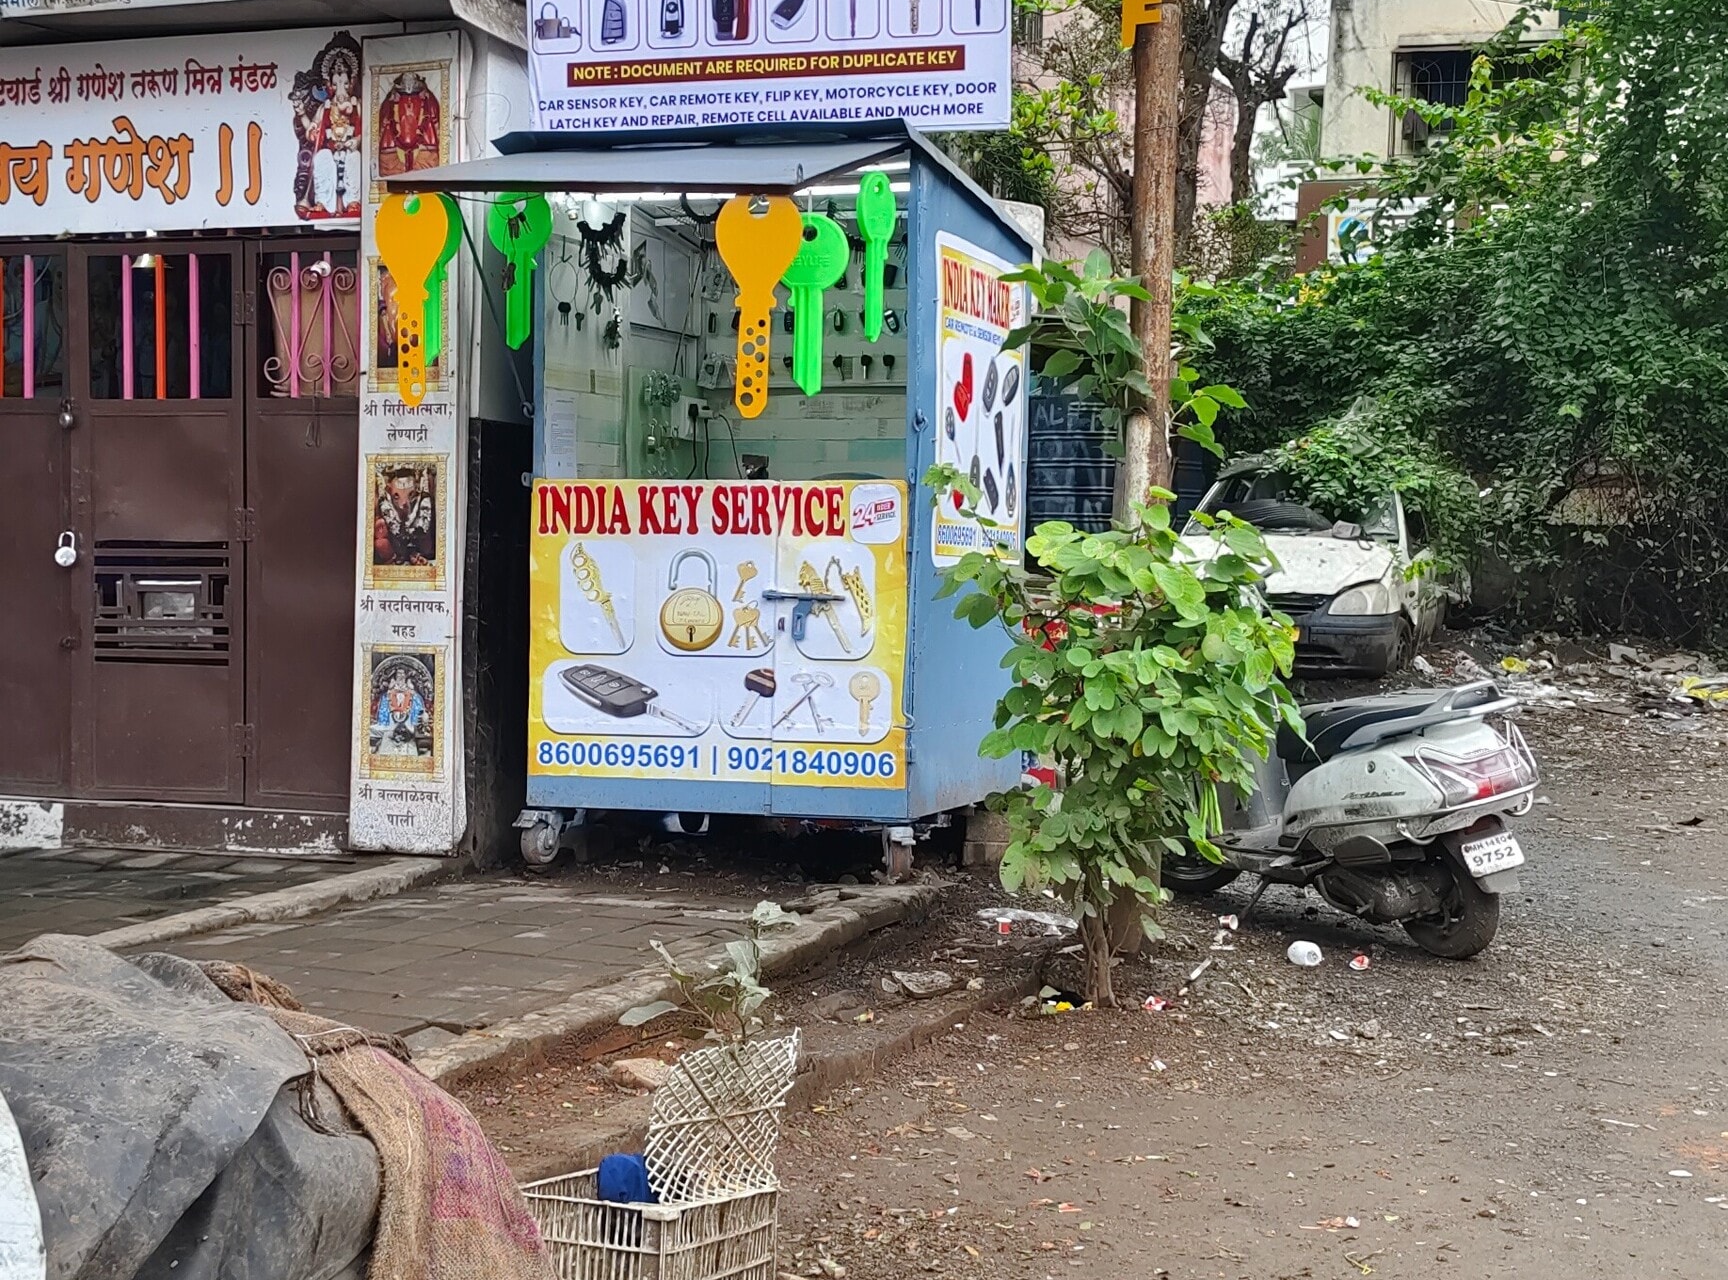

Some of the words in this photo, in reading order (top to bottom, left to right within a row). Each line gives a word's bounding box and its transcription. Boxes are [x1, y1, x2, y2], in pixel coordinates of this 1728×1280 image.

[47, 65, 71, 105] श्री
[76, 62, 126, 102] गणेश
[131, 67, 179, 99] तरूण
[184, 58, 224, 97] मित्र
[228, 53, 279, 94] मंडळ
[573, 66, 611, 81] NOTE
[620, 62, 703, 79] DOCUMENT
[705, 60, 733, 75] ARE
[735, 56, 808, 74] REQUIRED
[810, 55, 840, 70] FOR
[842, 51, 925, 68] DUPLICATE
[928, 50, 958, 65] KEY
[539, 99, 565, 112] CAR
[567, 97, 617, 110] SENSOR
[619, 96, 648, 110] KEY,
[649, 94, 678, 107] CAR
[680, 92, 732, 106] REMOTE
[734, 91, 763, 105] KEY,
[765, 90, 791, 102] FLIP
[794, 88, 824, 103] KEY,
[825, 84, 920, 100] MOTORCYCLE
[923, 83, 953, 98] KEY,
[955, 81, 997, 95] DOOR
[549, 118, 592, 130] LATCH
[593, 116, 619, 129] KEY
[620, 115, 649, 127] AND
[651, 113, 700, 127] REPAIR,
[702, 111, 756, 125] REMOTE
[757, 110, 787, 122] CELL
[789, 107, 863, 121] AVAILABLE
[865, 105, 895, 118] AND
[898, 103, 941, 117] MUCH
[943, 102, 984, 115] MORE
[64, 115, 194, 205] गणेश
[943, 257, 968, 315] INDIA
[970, 268, 987, 320] KEY
[363, 399, 378, 417] श्री
[537, 485, 632, 535] INDIA
[637, 485, 707, 536] KEY
[711, 485, 846, 538] SERVICE
[360, 596, 374, 613] श्री
[538, 741, 700, 770] 8600695691
[727, 746, 895, 778] 9021840906
[358, 786, 372, 802] श्री
[387, 812, 415, 828] पाली
[1472, 846, 1516, 867] 9752
